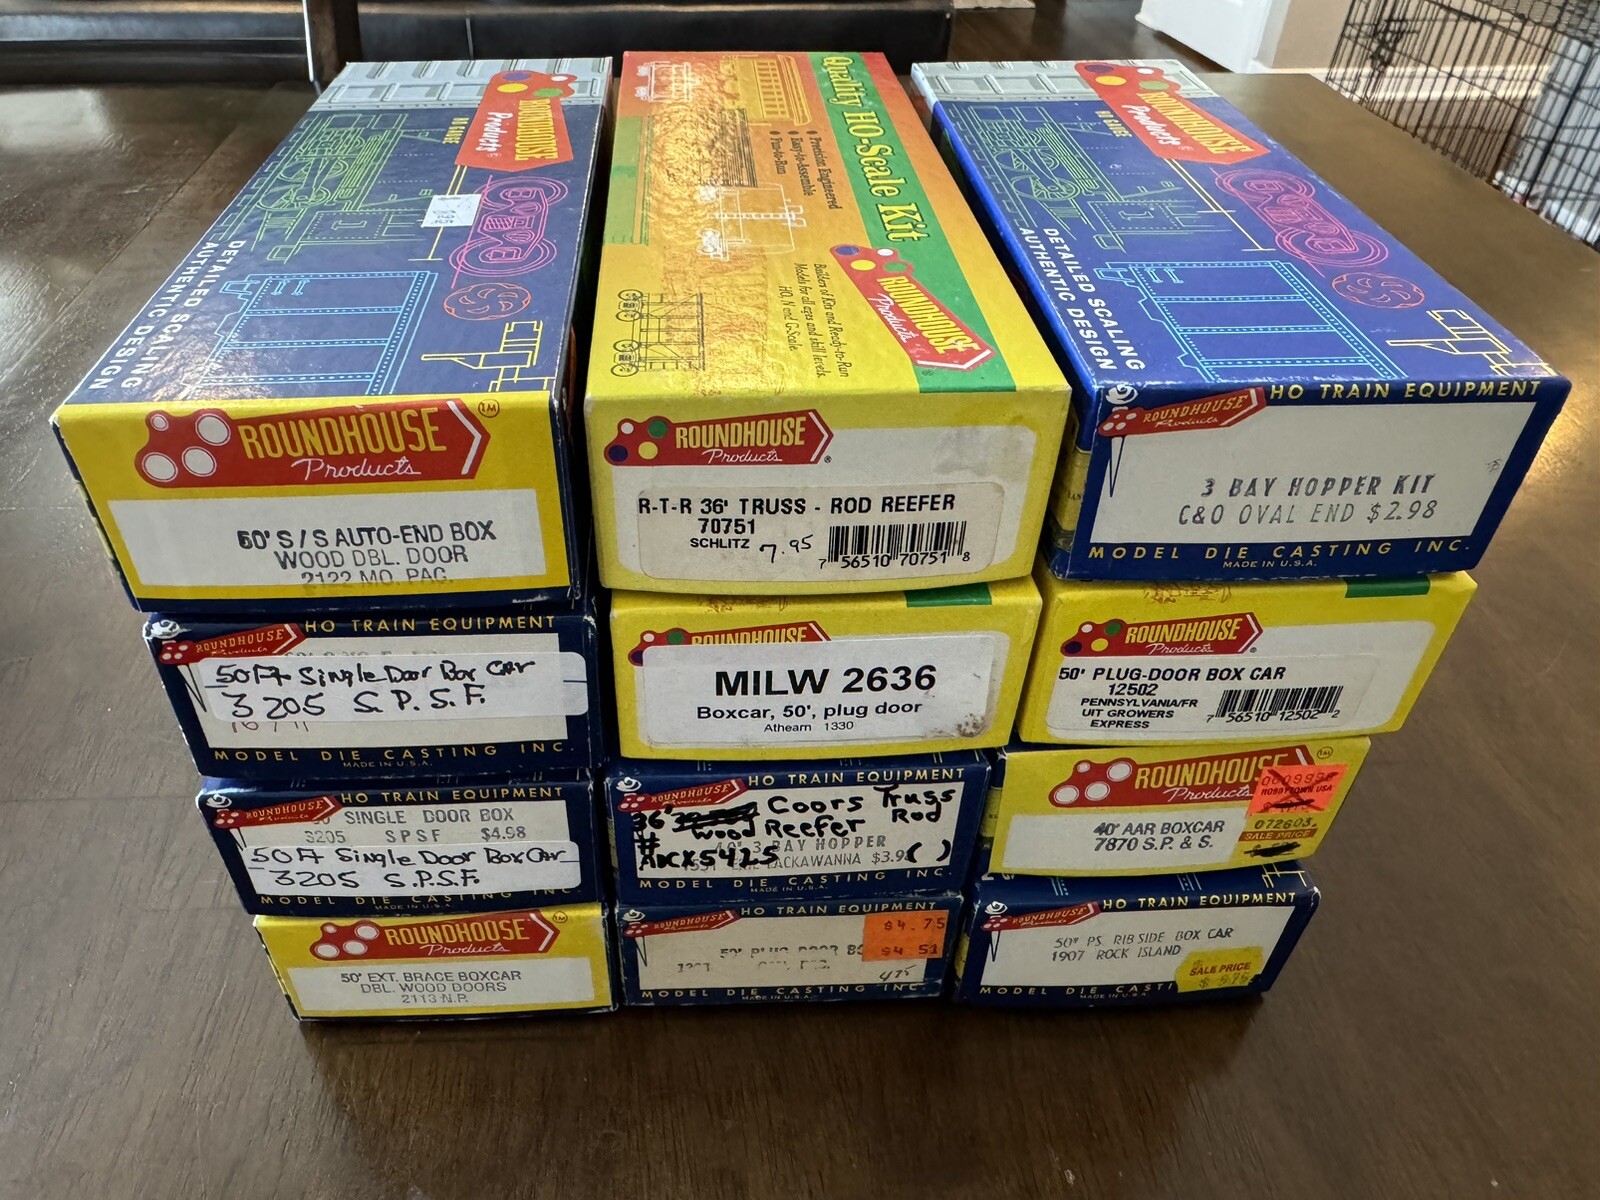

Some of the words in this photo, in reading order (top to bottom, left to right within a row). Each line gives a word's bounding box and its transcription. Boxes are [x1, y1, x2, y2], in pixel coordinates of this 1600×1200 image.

[1121, 105, 1181, 145] Products
[1136, 92, 1255, 154] ROUNDHOUSE
[822, 56, 863, 108] Quality
[843, 110, 906, 198] HO-Scale
[876, 202, 930, 242] Kit
[817, 168, 842, 209] Engineered
[148, 242, 219, 318] AUTHENTIC
[184, 240, 246, 307] DETAILED
[794, 263, 810, 284] Models
[814, 263, 830, 287] Builders
[799, 286, 812, 295] for
[1019, 227, 1076, 302] AUTHENTIC
[1067, 308, 1118, 370] DESIGN
[1044, 228, 1095, 293] DETAILED
[1088, 298, 1146, 371] SCALING
[802, 297, 815, 305] all
[783, 308, 798, 320] and
[801, 306, 813, 320] ages
[826, 312, 841, 325] and
[869, 293, 915, 343] Products
[877, 276, 981, 354] ROUNDHOUSE
[807, 323, 823, 336] and
[121, 313, 189, 388] SCALING
[810, 337, 826, 352] skill
[829, 325, 852, 377] Ready-to-Run
[88, 325, 155, 389] DESIGN
[1270, 384, 1303, 400] HO
[1320, 384, 1390, 399] TRAIN
[1405, 381, 1541, 398] EQUIPMENT
[1143, 395, 1249, 423] ROUNDHOUSE
[238, 407, 447, 459] ROUNDHOUSE
[676, 416, 806, 448] ROUNDHOUSE
[702, 449, 783, 464] Products
[291, 456, 421, 480] Products
[1201, 478, 1215, 497] 3
[1229, 477, 1277, 497] BAY
[1287, 475, 1382, 497] HOPPER
[1393, 473, 1437, 495] KIT
[638, 498, 692, 514] R-T-R
[701, 499, 728, 514] 36'
[740, 498, 806, 515] TRUSS
[830, 497, 872, 514] ROD
[881, 494, 955, 513] REEFER
[1179, 504, 1224, 525] C&O
[1239, 504, 1295, 524] OVAL
[1309, 503, 1355, 523] END
[1367, 500, 1438, 523] $2.98
[336, 525, 443, 547] AUTO-END
[450, 520, 497, 541] BOX
[698, 518, 755, 534] 70751
[690, 538, 750, 549] SCHLITZ
[759, 534, 813, 563] 7.95
[1089, 547, 1179, 559] MODEL
[1205, 547, 1248, 559] DIE
[1272, 542, 1392, 558] CASTING
[1415, 540, 1469, 552] INC.
[274, 550, 344, 570] WOOD
[354, 548, 400, 566] DBL.
[407, 544, 468, 564] DOOR
[819, 559, 827, 569] 7
[840, 554, 890, 568] 56510
[900, 553, 947, 566] 70751
[962, 551, 970, 561] 8
[305, 620, 335, 632] HO
[352, 618, 416, 632] TRAIN
[430, 616, 555, 631] EQUIPMENT
[1125, 618, 1243, 644] ROUNDHOUSE
[196, 629, 285, 653] ROUNDHOUSE
[1146, 643, 1214, 655] Products
[716, 669, 830, 696] MILW
[842, 665, 936, 694] 2636
[1058, 668, 1085, 680] 50'
[1093, 668, 1201, 680] PLUG-DOOR
[1206, 668, 1246, 681] BOX
[1249, 667, 1286, 680] CAR
[1108, 684, 1159, 696] 12502
[697, 706, 774, 720] Boxcar,
[783, 705, 816, 719] 50',
[824, 704, 868, 720] plug
[875, 702, 922, 714] door
[1081, 698, 1198, 707] PENNSYLVANIA/FR
[1108, 710, 1174, 718] GROWERS
[1226, 712, 1271, 722] 56510
[1280, 710, 1320, 720] 12502
[1332, 710, 1340, 718] 2
[825, 721, 854, 731] 1330
[1090, 720, 1150, 728] EXPRESS
[215, 752, 298, 761] MODEL
[321, 752, 360, 761] DIE
[384, 746, 496, 759] CASTING
[520, 743, 574, 753] INC.
[748, 776, 775, 786] HO
[788, 772, 844, 785] TRAIN
[857, 768, 964, 782] EQUIPMENT
[341, 793, 368, 803] HO
[381, 791, 439, 802] TRAIN
[453, 787, 562, 800] EQUIPMENT
[651, 784, 731, 803] ROUNDHOUSE
[767, 795, 864, 814] Coors
[873, 784, 956, 808] Truss
[246, 800, 324, 819] ROUNDHOUSE
[344, 810, 407, 824] SINGLE
[423, 809, 471, 823] DOOR
[480, 808, 514, 822] BOX
[765, 814, 866, 838] Reefer
[892, 803, 941, 823] Rod
[1122, 822, 1156, 835] AAR
[1161, 821, 1225, 834] BOXCAR
[305, 830, 346, 843] 3205
[816, 835, 886, 850] HOPPER
[1093, 837, 1138, 851] 7870
[1181, 837, 1192, 849] &
[418, 850, 476, 865] Door
[269, 870, 359, 888] 3205
[640, 880, 712, 888] MODEL
[734, 879, 767, 887] DIE
[788, 871, 886, 886] CASTING
[906, 868, 952, 878] INC.
[741, 907, 765, 915] HO
[777, 905, 828, 915] TRAIN
[839, 902, 936, 913] EQUIPMENT
[1103, 900, 1127, 909] HO
[1138, 896, 1188, 908] TRAIN
[1200, 892, 1296, 905] EQUIPMENT
[384, 919, 530, 945] ROUNDHOUSE
[1175, 930, 1201, 941] BOX
[1208, 928, 1234, 939] CAR
[420, 943, 510, 955] Products
[1052, 950, 1085, 961] 1907
[1097, 949, 1130, 959] ROCK
[1138, 945, 1181, 957] ISLAND
[368, 973, 398, 982] EXT.
[403, 972, 454, 982] BRACE
[459, 971, 522, 981] BOXCAR
[1190, 966, 1217, 976] SALE
[1219, 962, 1251, 972] PRICE
[361, 984, 395, 993] DBL.
[399, 984, 446, 992] WOOD
[452, 982, 507, 992] DOORS
[642, 990, 708, 998] MODEL
[776, 985, 865, 995] CASTING
